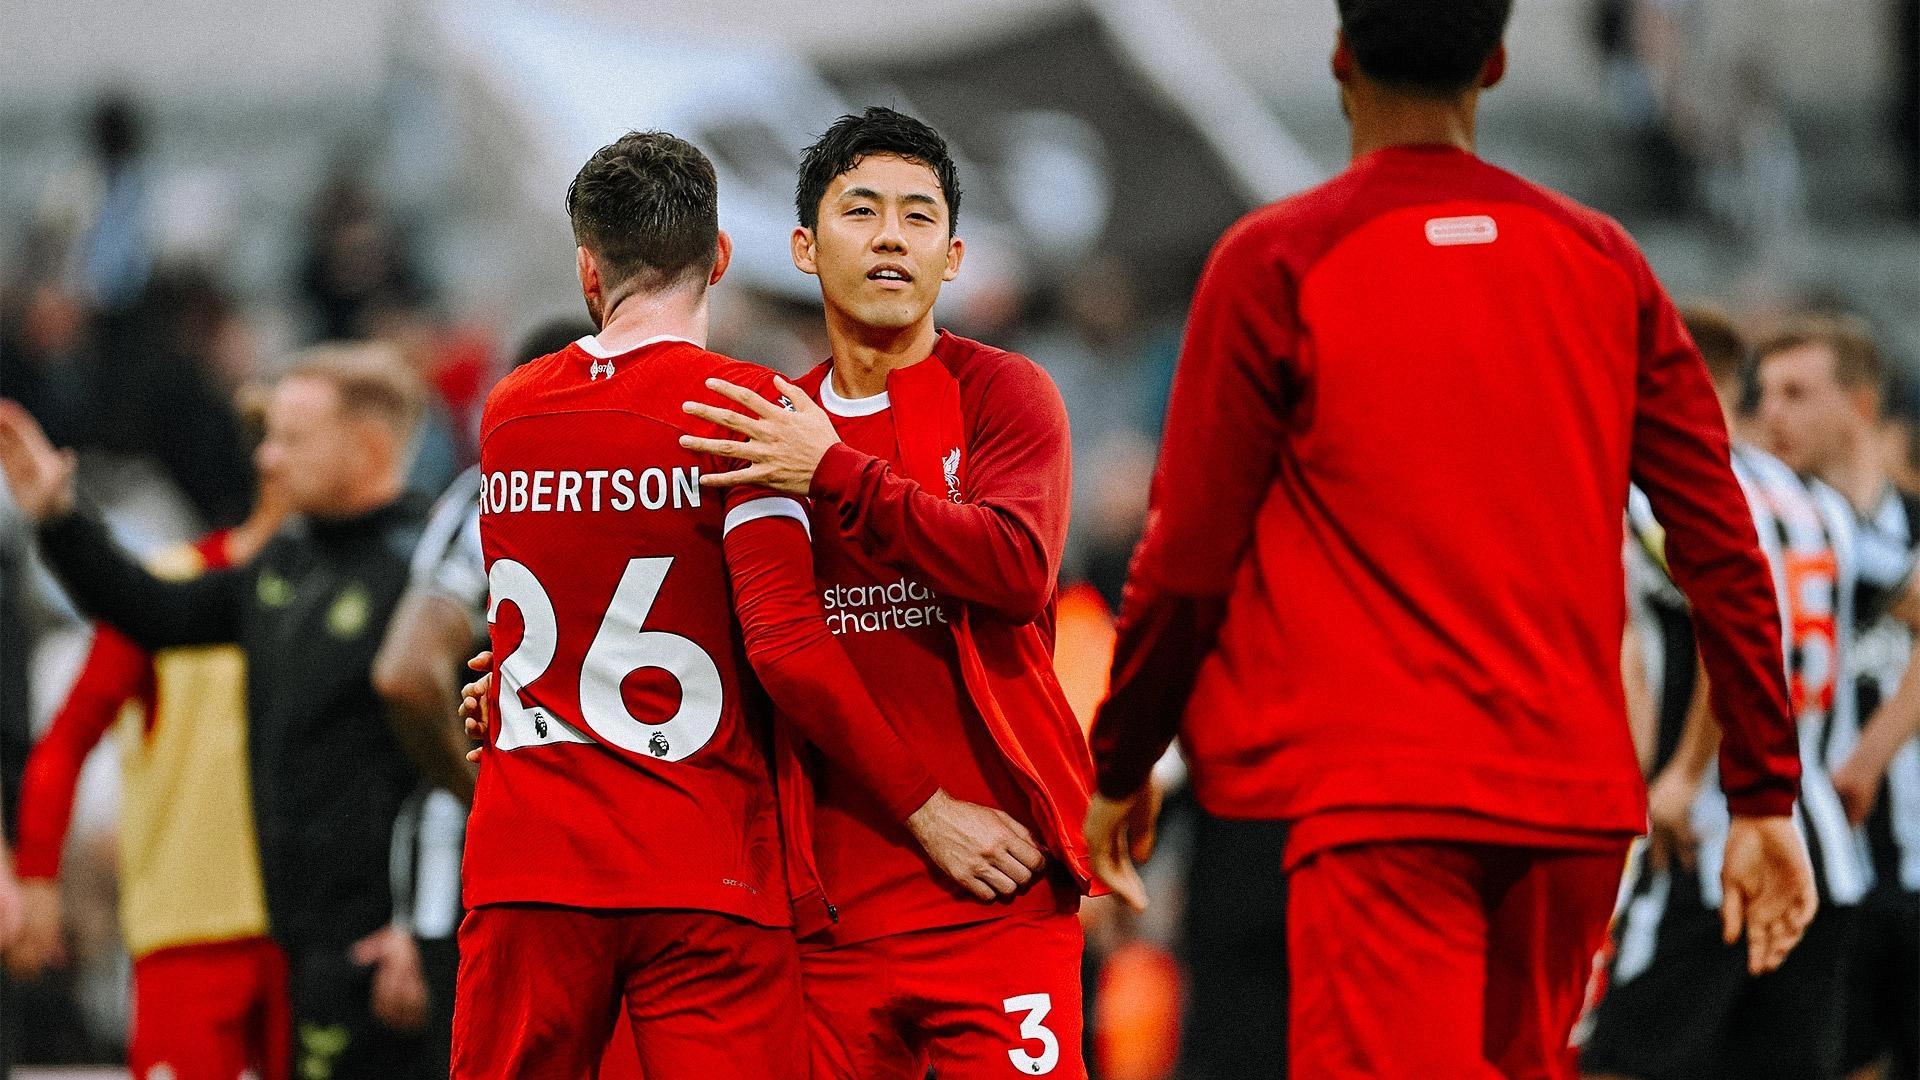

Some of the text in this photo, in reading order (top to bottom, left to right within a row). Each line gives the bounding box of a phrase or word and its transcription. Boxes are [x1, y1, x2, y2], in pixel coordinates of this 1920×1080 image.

[598, 364, 607, 373] 97
[480, 466, 701, 516] ROBERTSON
[823, 577, 936, 609] standa
[487, 556, 723, 763] 26
[1002, 992, 1060, 1076] 3
